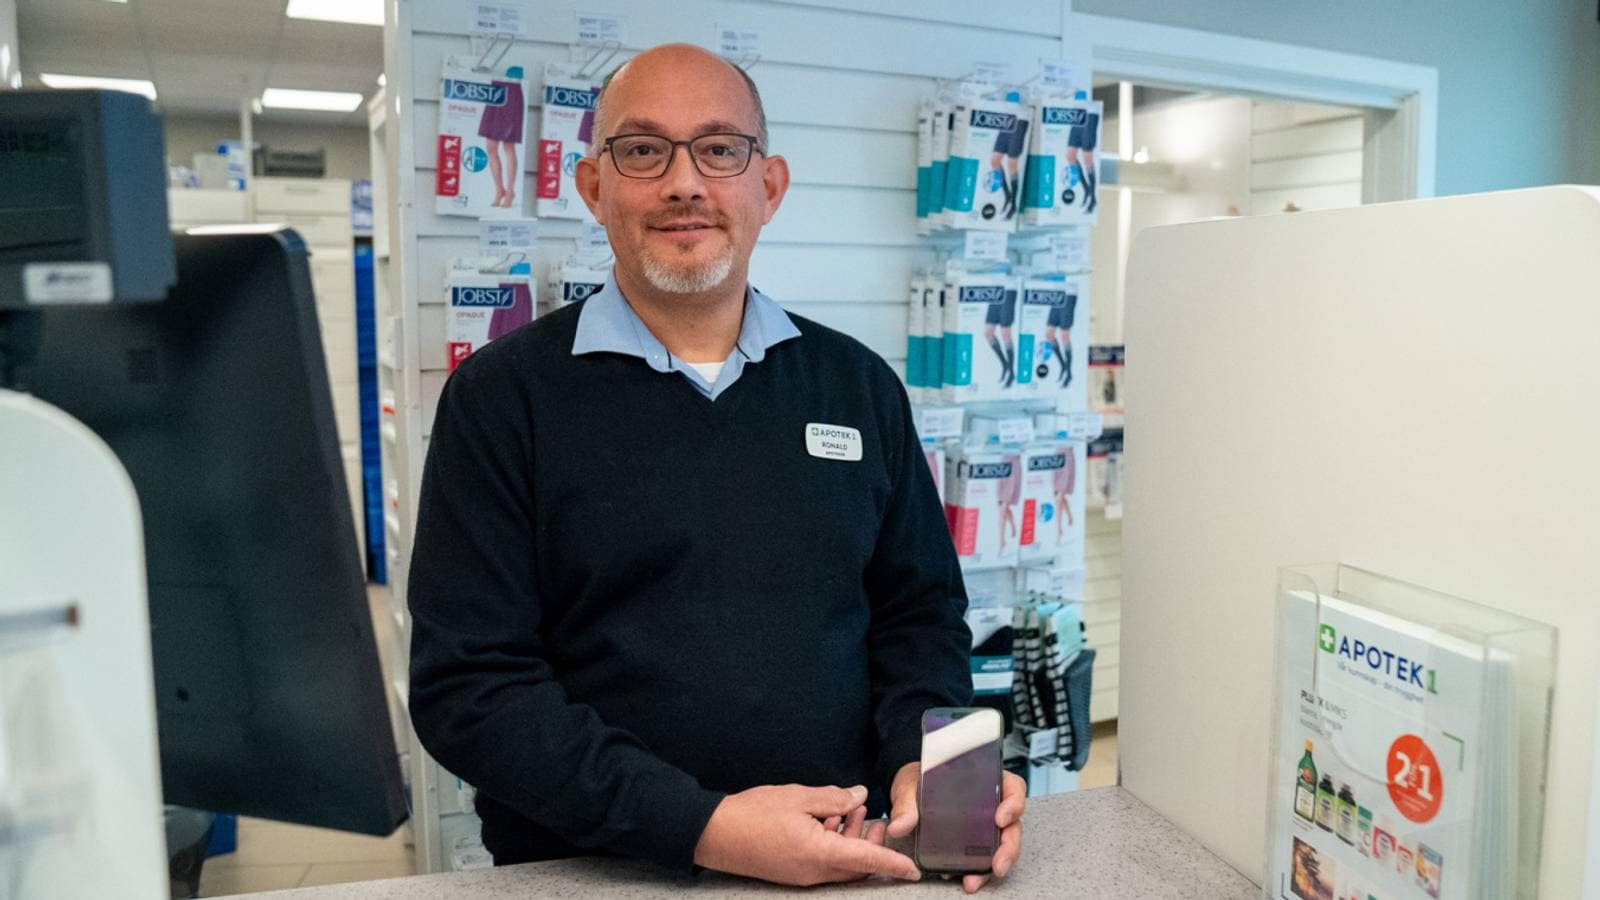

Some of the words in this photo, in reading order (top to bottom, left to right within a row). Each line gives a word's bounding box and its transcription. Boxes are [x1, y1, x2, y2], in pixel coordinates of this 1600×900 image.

[448, 80, 496, 100] JOBST
[551, 87, 595, 107] JOBST
[1046, 107, 1080, 124] JOBST
[456, 287, 503, 306] JOBST
[456, 311, 485, 319] OPAQUE
[821, 429, 851, 440] APOTEK
[822, 441, 848, 450] RONALD
[1339, 635, 1424, 688] APOTEK
[1427, 669, 1438, 694] 1
[1394, 750, 1411, 788] 2
[1417, 764, 1433, 801] 1
